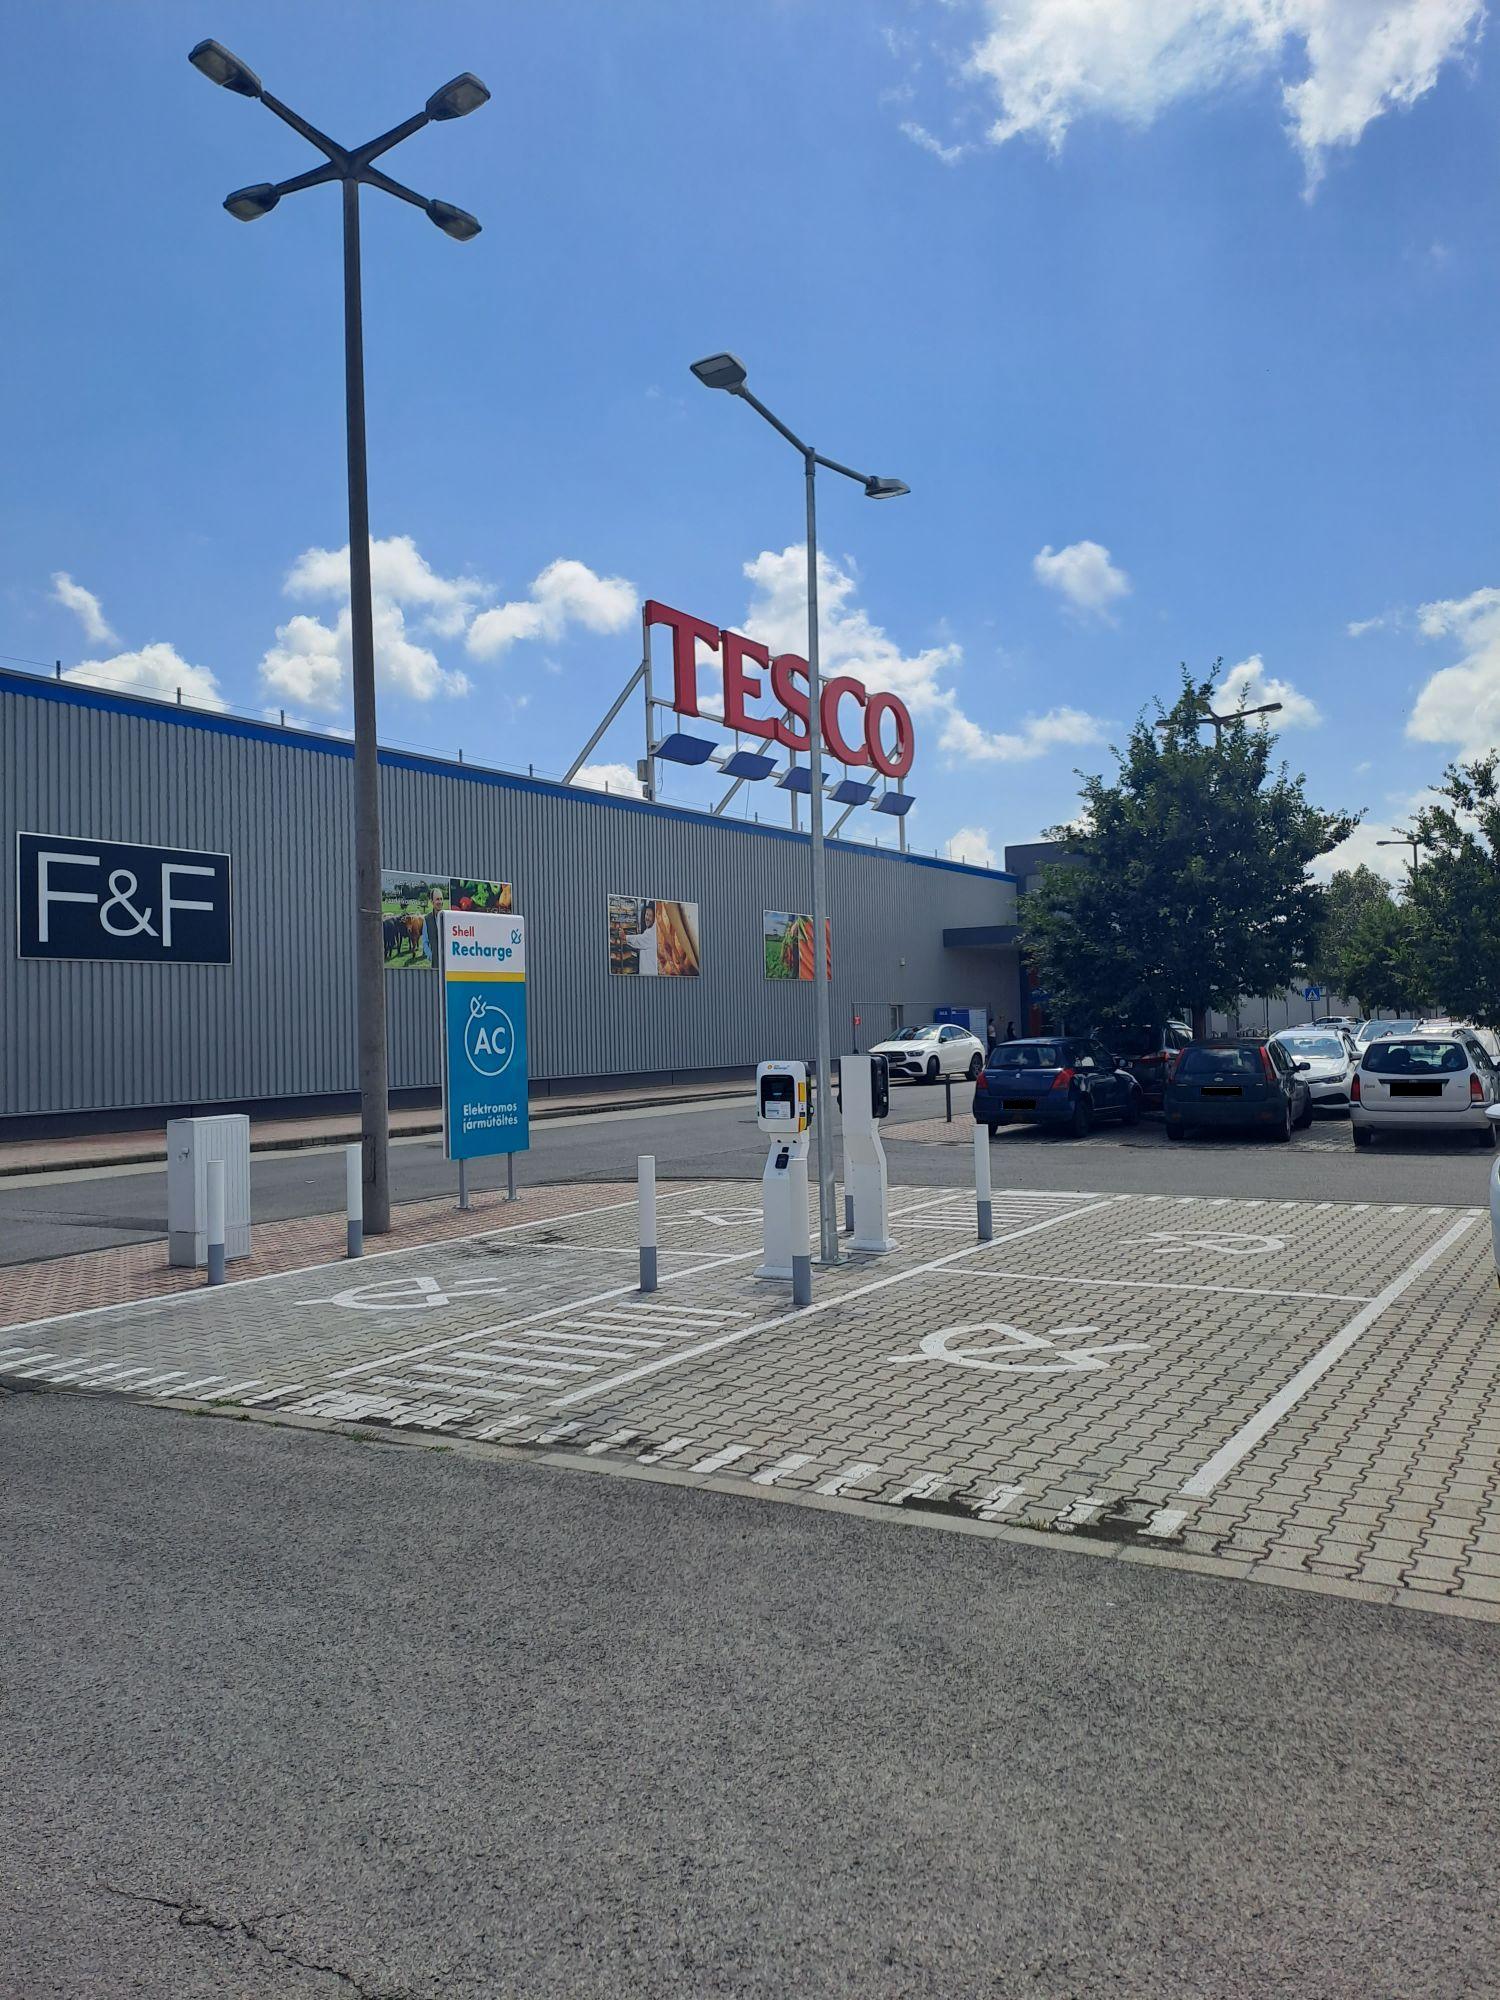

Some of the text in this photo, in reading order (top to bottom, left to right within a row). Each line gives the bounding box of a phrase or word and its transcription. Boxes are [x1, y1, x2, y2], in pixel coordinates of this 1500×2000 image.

[645, 600, 914, 778] TESCO
[38, 851, 216, 947] F&F
[452, 925, 475, 937] Shell
[452, 941, 513, 961] Recharge
[474, 1026, 506, 1055] AC
[463, 1102, 518, 1117] Elektromos
[463, 1113, 519, 1134] járműtöltés
